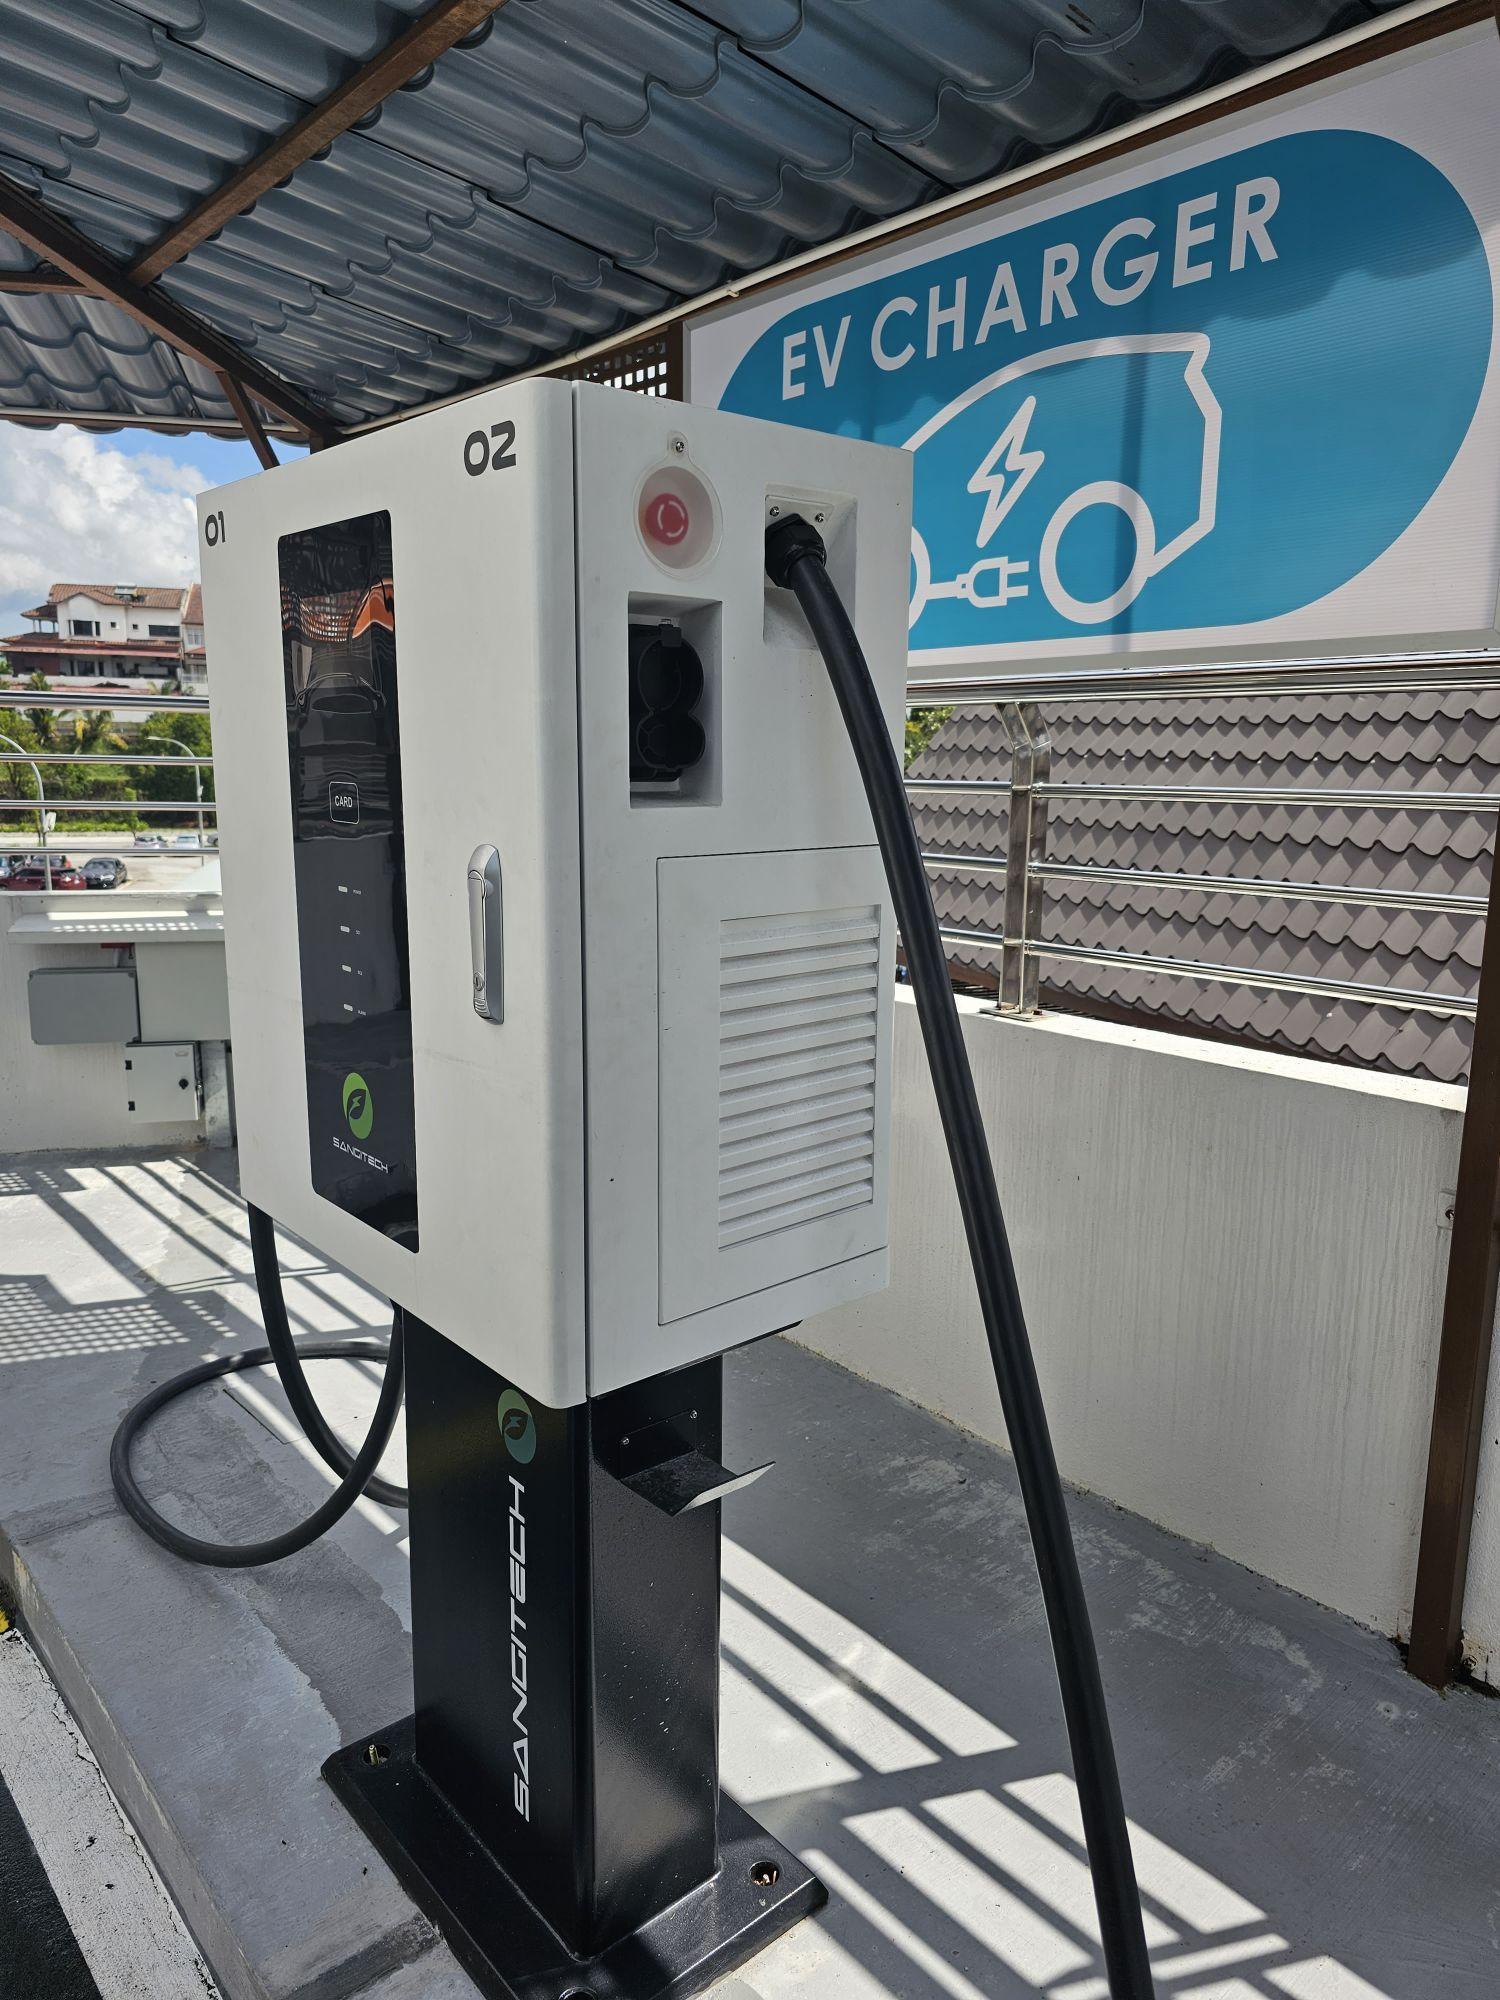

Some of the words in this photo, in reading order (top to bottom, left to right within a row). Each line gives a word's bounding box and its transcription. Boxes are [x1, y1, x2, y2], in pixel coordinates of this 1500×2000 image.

[782, 315, 852, 400] EV
[870, 176, 1281, 371] CHARGER
[463, 420, 517, 477] 02
[204, 510, 226, 547] 01
[334, 795, 353, 808] CARD
[332, 1136, 389, 1174] SANGITECH
[508, 1475, 530, 1823] SANGITECH
